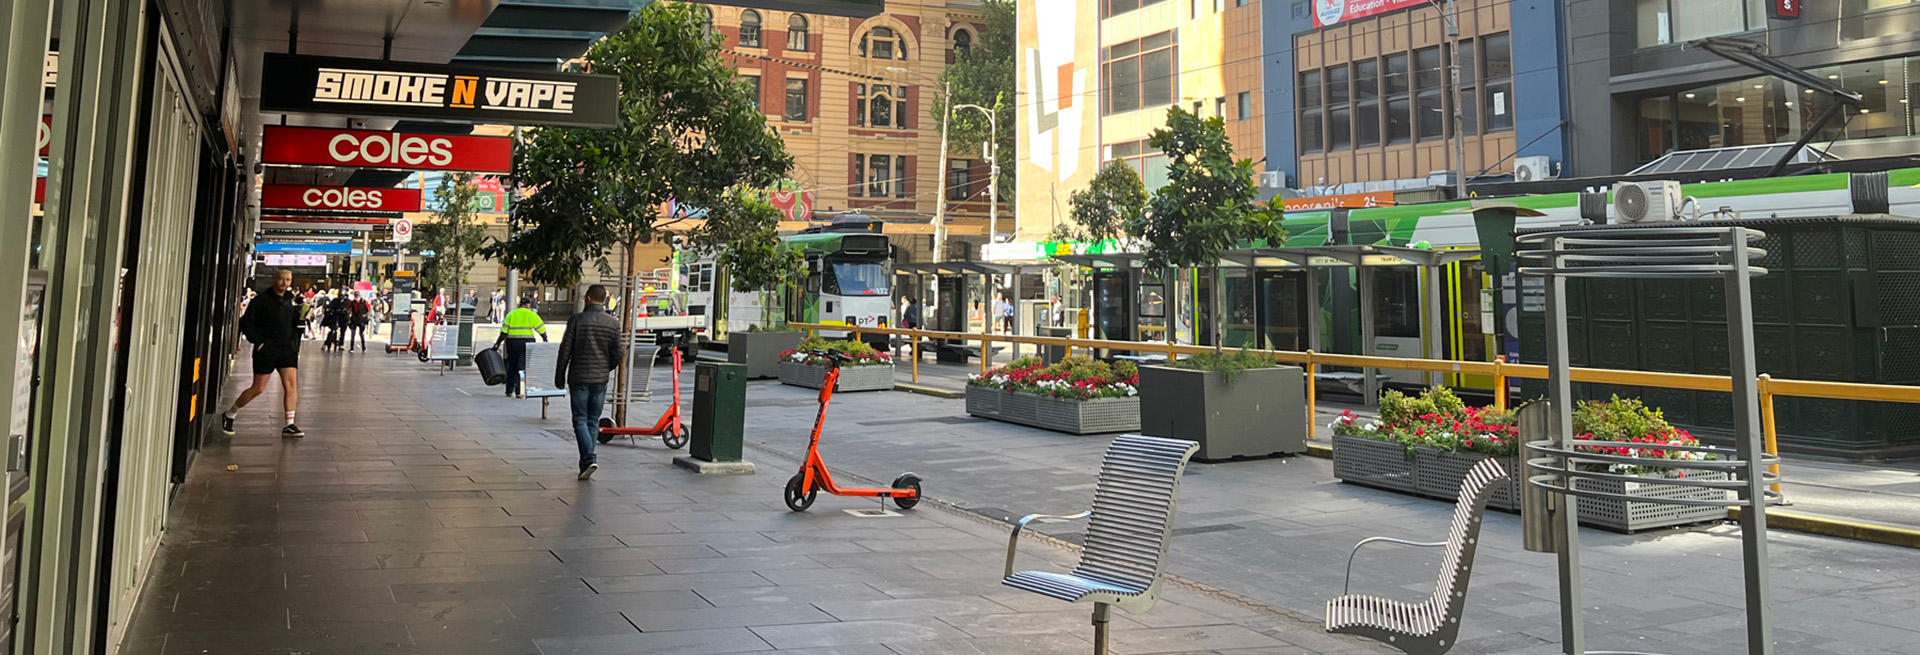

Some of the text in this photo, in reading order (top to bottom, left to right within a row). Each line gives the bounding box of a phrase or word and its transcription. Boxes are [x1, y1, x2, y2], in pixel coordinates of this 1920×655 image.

[315, 70, 577, 110] SMOKE N VAPE
[328, 132, 453, 166] coles
[303, 187, 383, 208] coles
